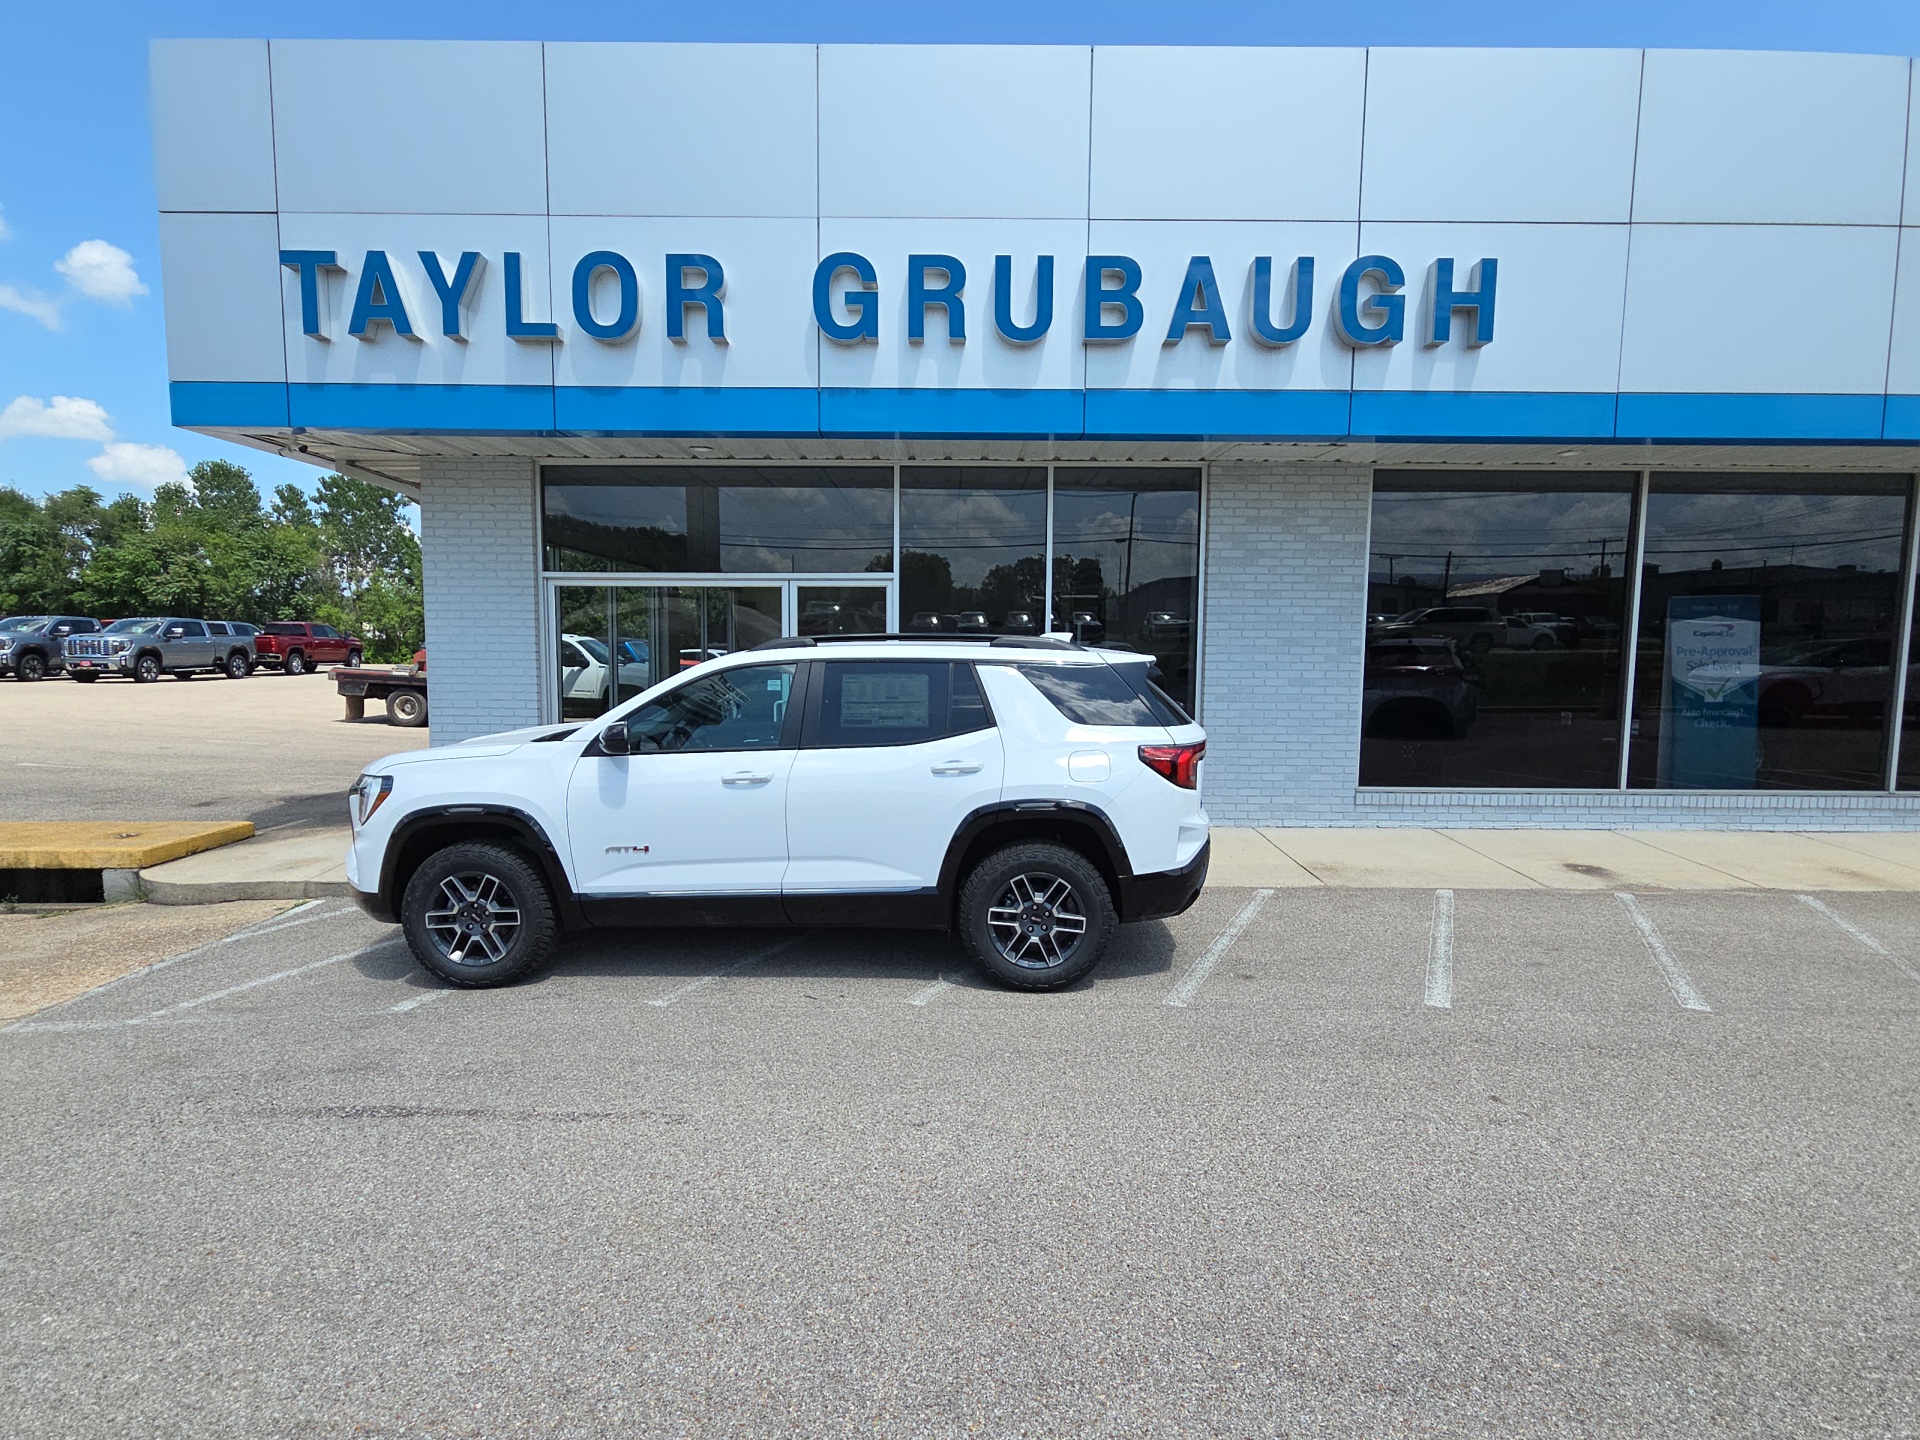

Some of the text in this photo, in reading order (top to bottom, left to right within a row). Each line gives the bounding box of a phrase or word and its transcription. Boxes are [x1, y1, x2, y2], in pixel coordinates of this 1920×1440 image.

[279, 250, 1499, 347] TAYLOR GRUBAUGH
[1676, 645, 1753, 659] Pre-Approval
[1686, 660, 1742, 671] Sale Event
[1680, 708, 1701, 717] Auto
